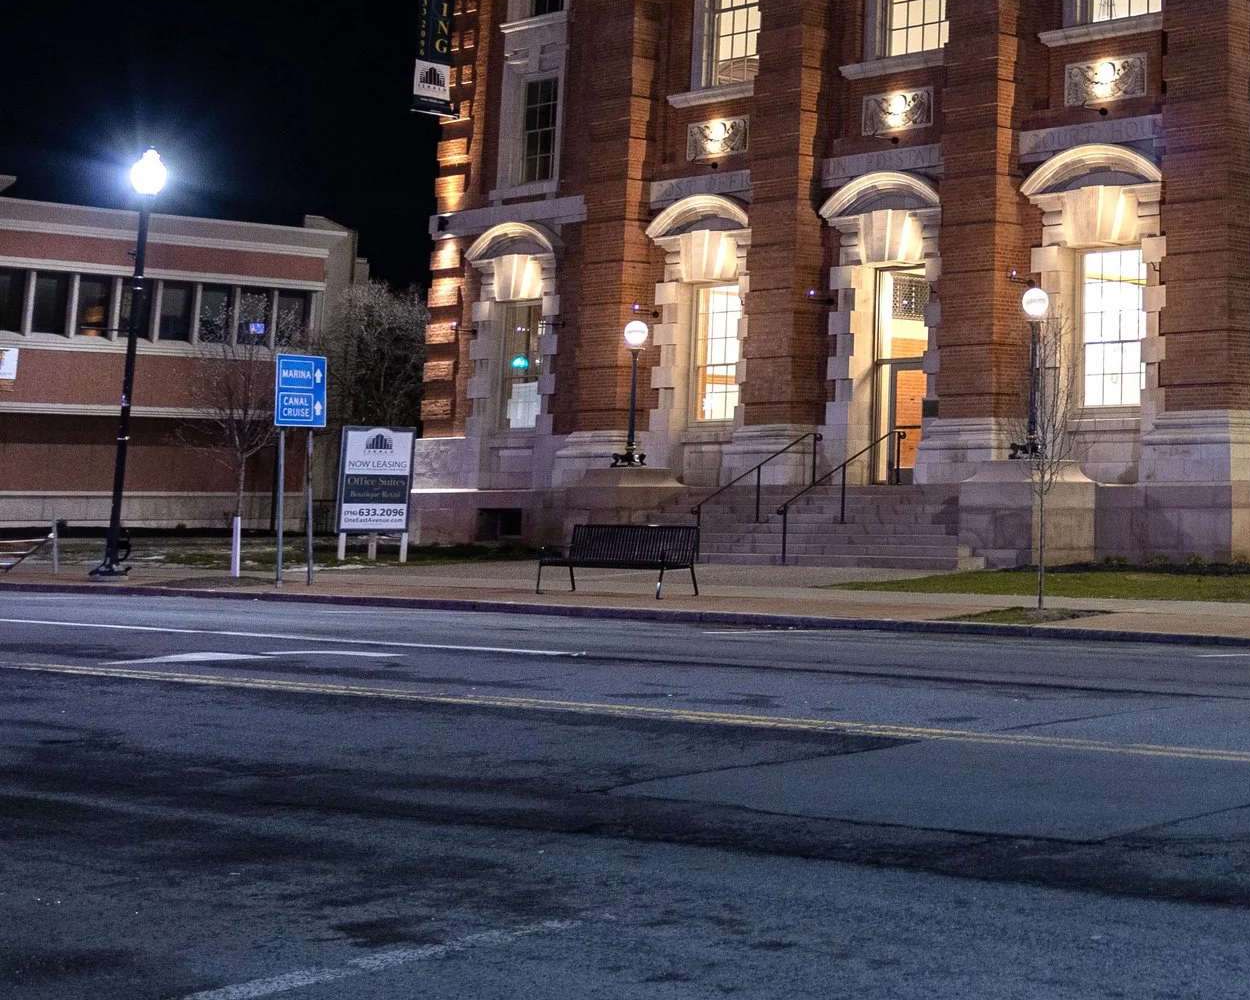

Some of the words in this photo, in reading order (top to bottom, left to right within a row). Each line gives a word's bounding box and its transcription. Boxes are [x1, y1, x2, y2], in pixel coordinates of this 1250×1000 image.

[1028, 125, 1095, 149] COURT
[1111, 117, 1162, 142] HOUS
[896, 146, 940, 168] STAT
[705, 172, 752, 192] OFFIC
[282, 369, 312, 379] MARINA
[283, 396, 309, 406] CANAL
[282, 407, 310, 417] CRUISE
[348, 460, 371, 468] NOW
[372, 460, 407, 468] LEASING
[347, 475, 376, 486] Office
[378, 477, 406, 486] Suites
[358, 508, 404, 517] 633.2096
